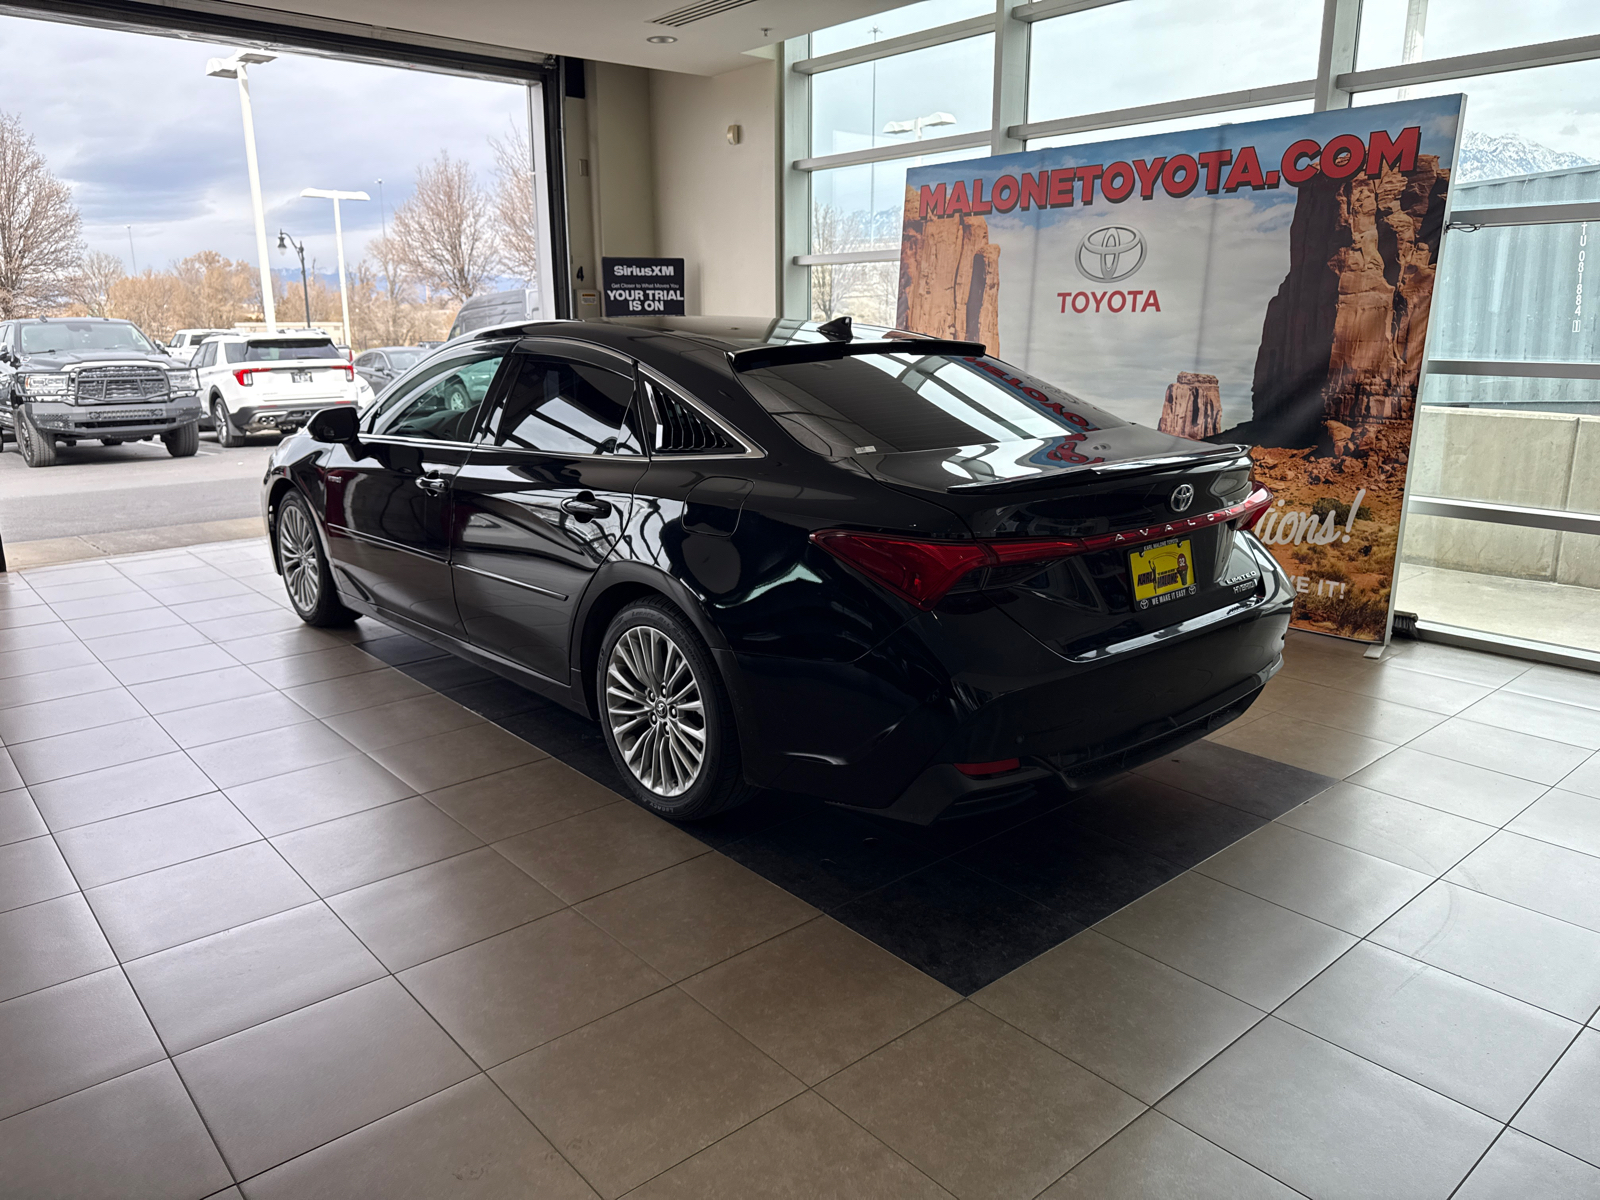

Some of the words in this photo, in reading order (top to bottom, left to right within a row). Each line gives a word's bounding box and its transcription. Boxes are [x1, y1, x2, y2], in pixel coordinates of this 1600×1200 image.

[920, 126, 1421, 220] MALONETOYOTA.COM
[576, 265, 584, 282] 4
[613, 265, 675, 276] SiriusXM
[607, 290, 644, 301] YOUR
[646, 290, 685, 301] TRIAL
[1057, 290, 1161, 313] TOYOTA
[628, 300, 642, 311] IS
[644, 300, 664, 311] ON
[1115, 508, 1233, 541] AVALON
[1178, 557, 1186, 567] 32
[1225, 570, 1257, 585] LIMITED
[1151, 597, 1159, 605] WE
[1159, 594, 1171, 603] MAKE
[1176, 589, 1187, 598] EASY
[1317, 579, 1346, 600] IT!
